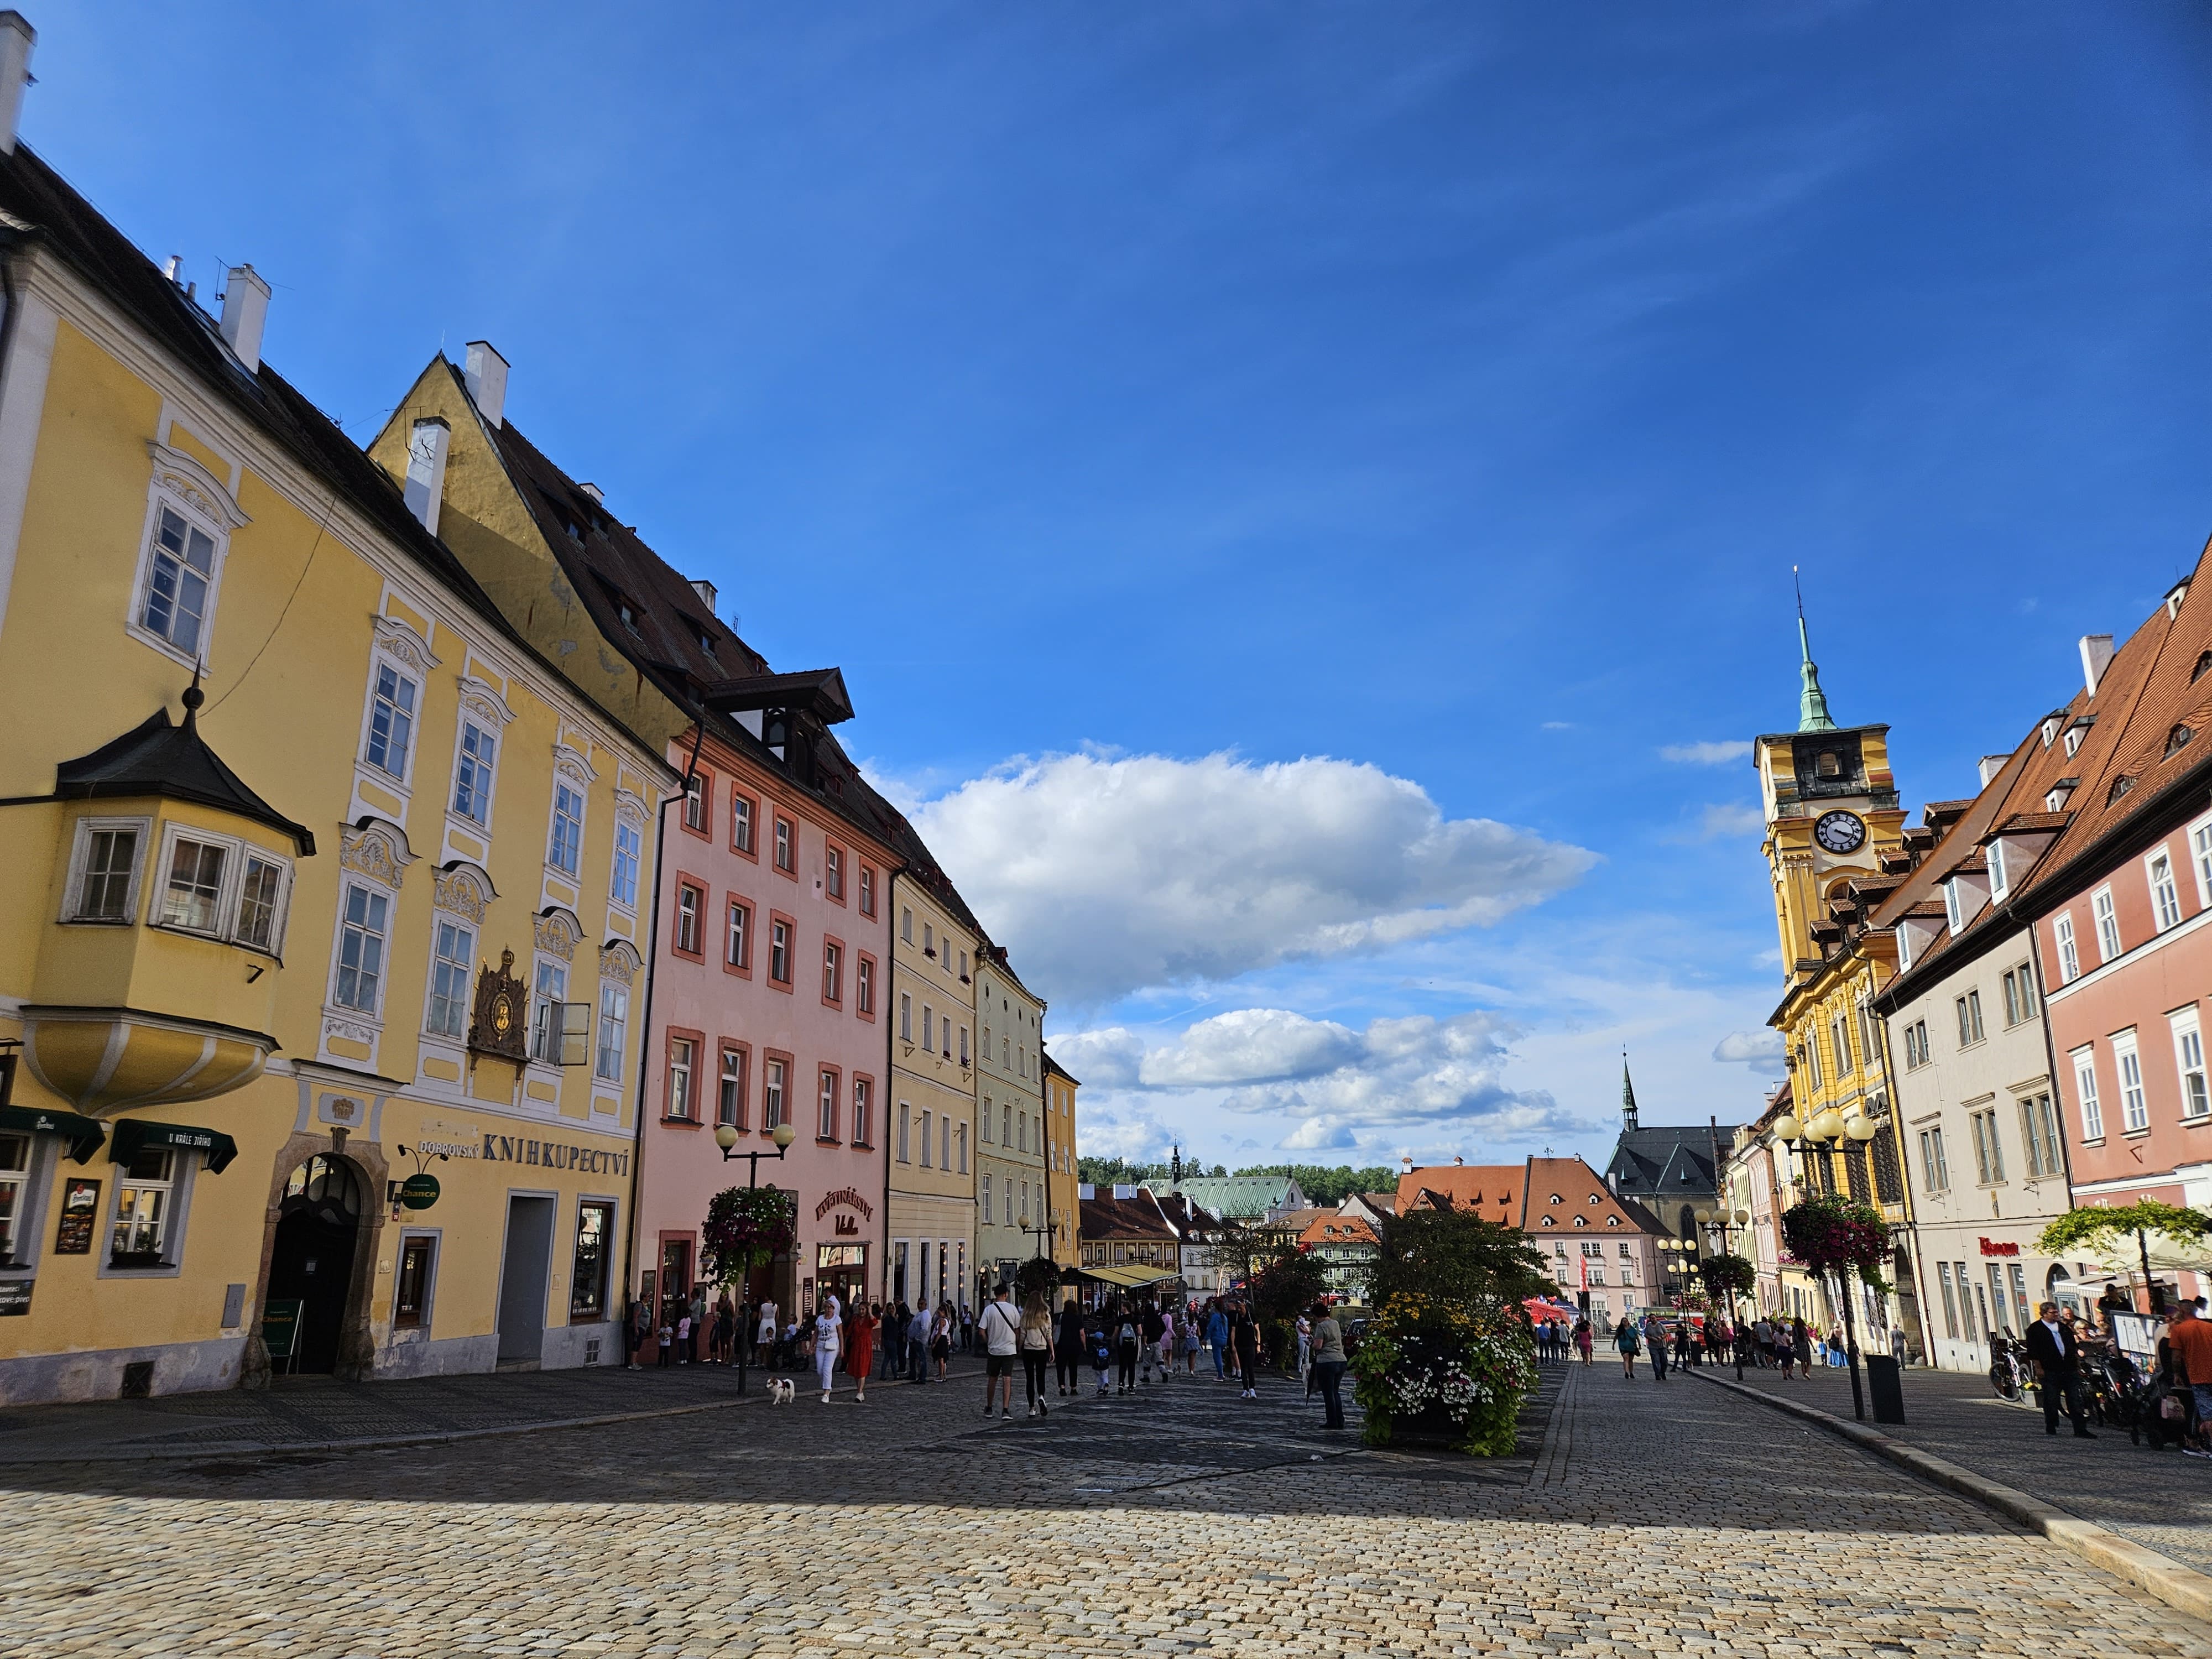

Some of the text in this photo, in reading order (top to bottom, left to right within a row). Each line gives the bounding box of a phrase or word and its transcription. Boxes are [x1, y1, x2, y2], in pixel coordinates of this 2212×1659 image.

[169, 1133, 211, 1147] U KRÁLE JIŘÍHO
[418, 1134, 629, 1177] DOBROVSKÝ KNIHKUPECTVÍ
[402, 1190, 437, 1198] Chance
